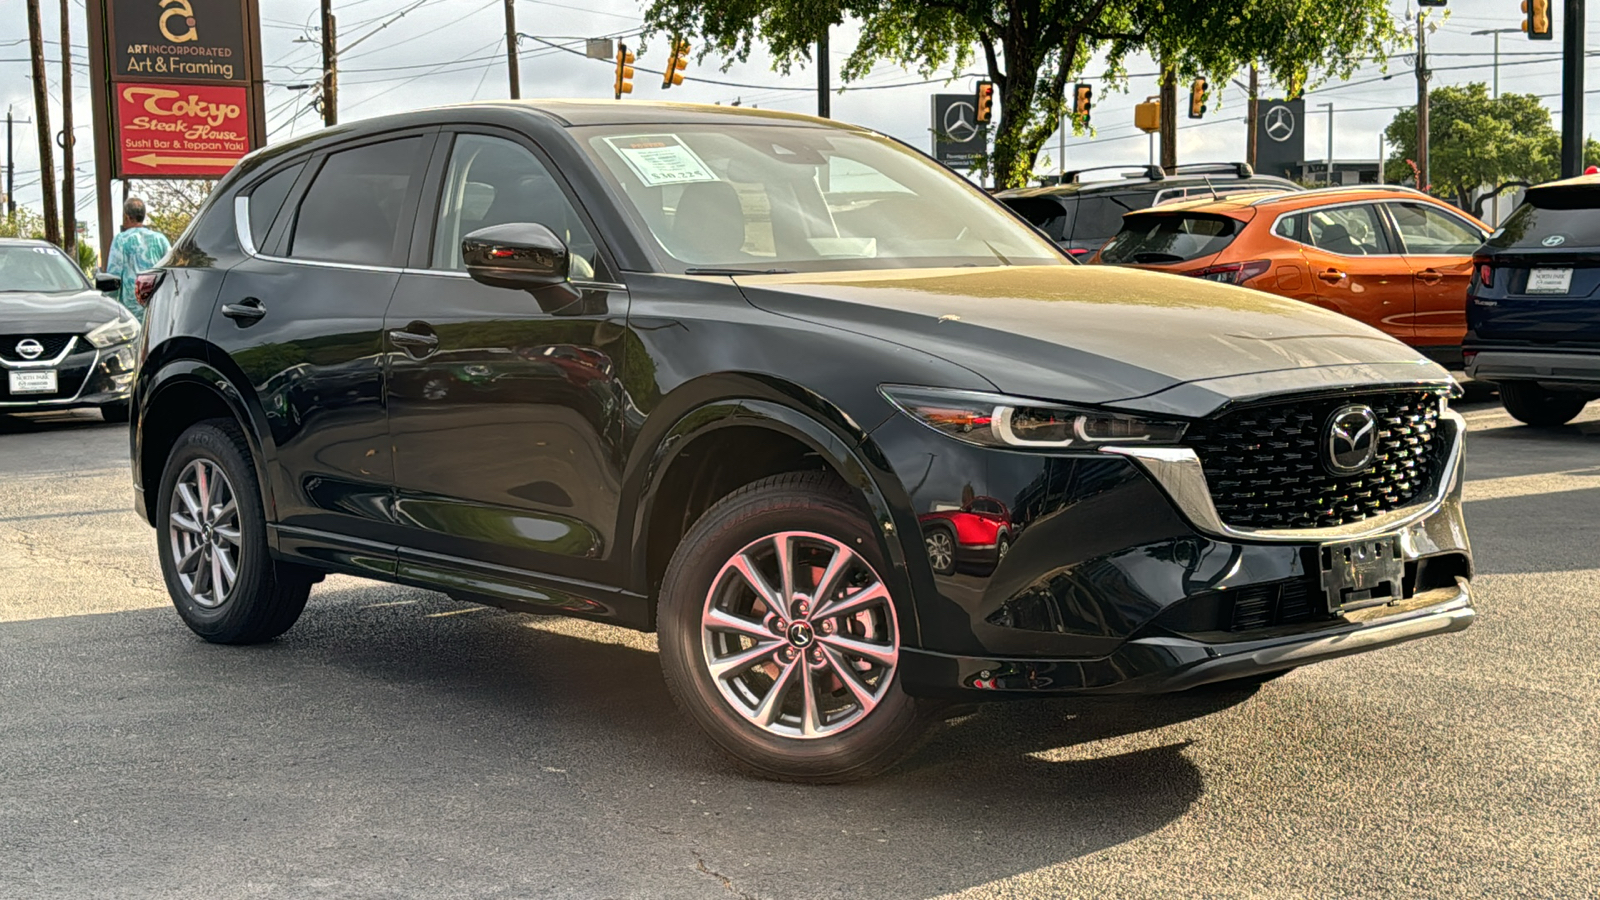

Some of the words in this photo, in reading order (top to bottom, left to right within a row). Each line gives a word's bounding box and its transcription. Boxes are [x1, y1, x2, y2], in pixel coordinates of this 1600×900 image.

[127, 56, 152, 72] Art
[155, 57, 167, 72] &
[170, 57, 233, 79] Framing
[123, 87, 240, 126] Tokyo
[124, 116, 188, 132] Steak
[184, 125, 246, 140] House
[125, 138, 151, 148] Sushi
[153, 139, 170, 149] Bar
[173, 140, 181, 149] &
[183, 140, 222, 151] Teppan
[223, 141, 244, 151] Yaki
